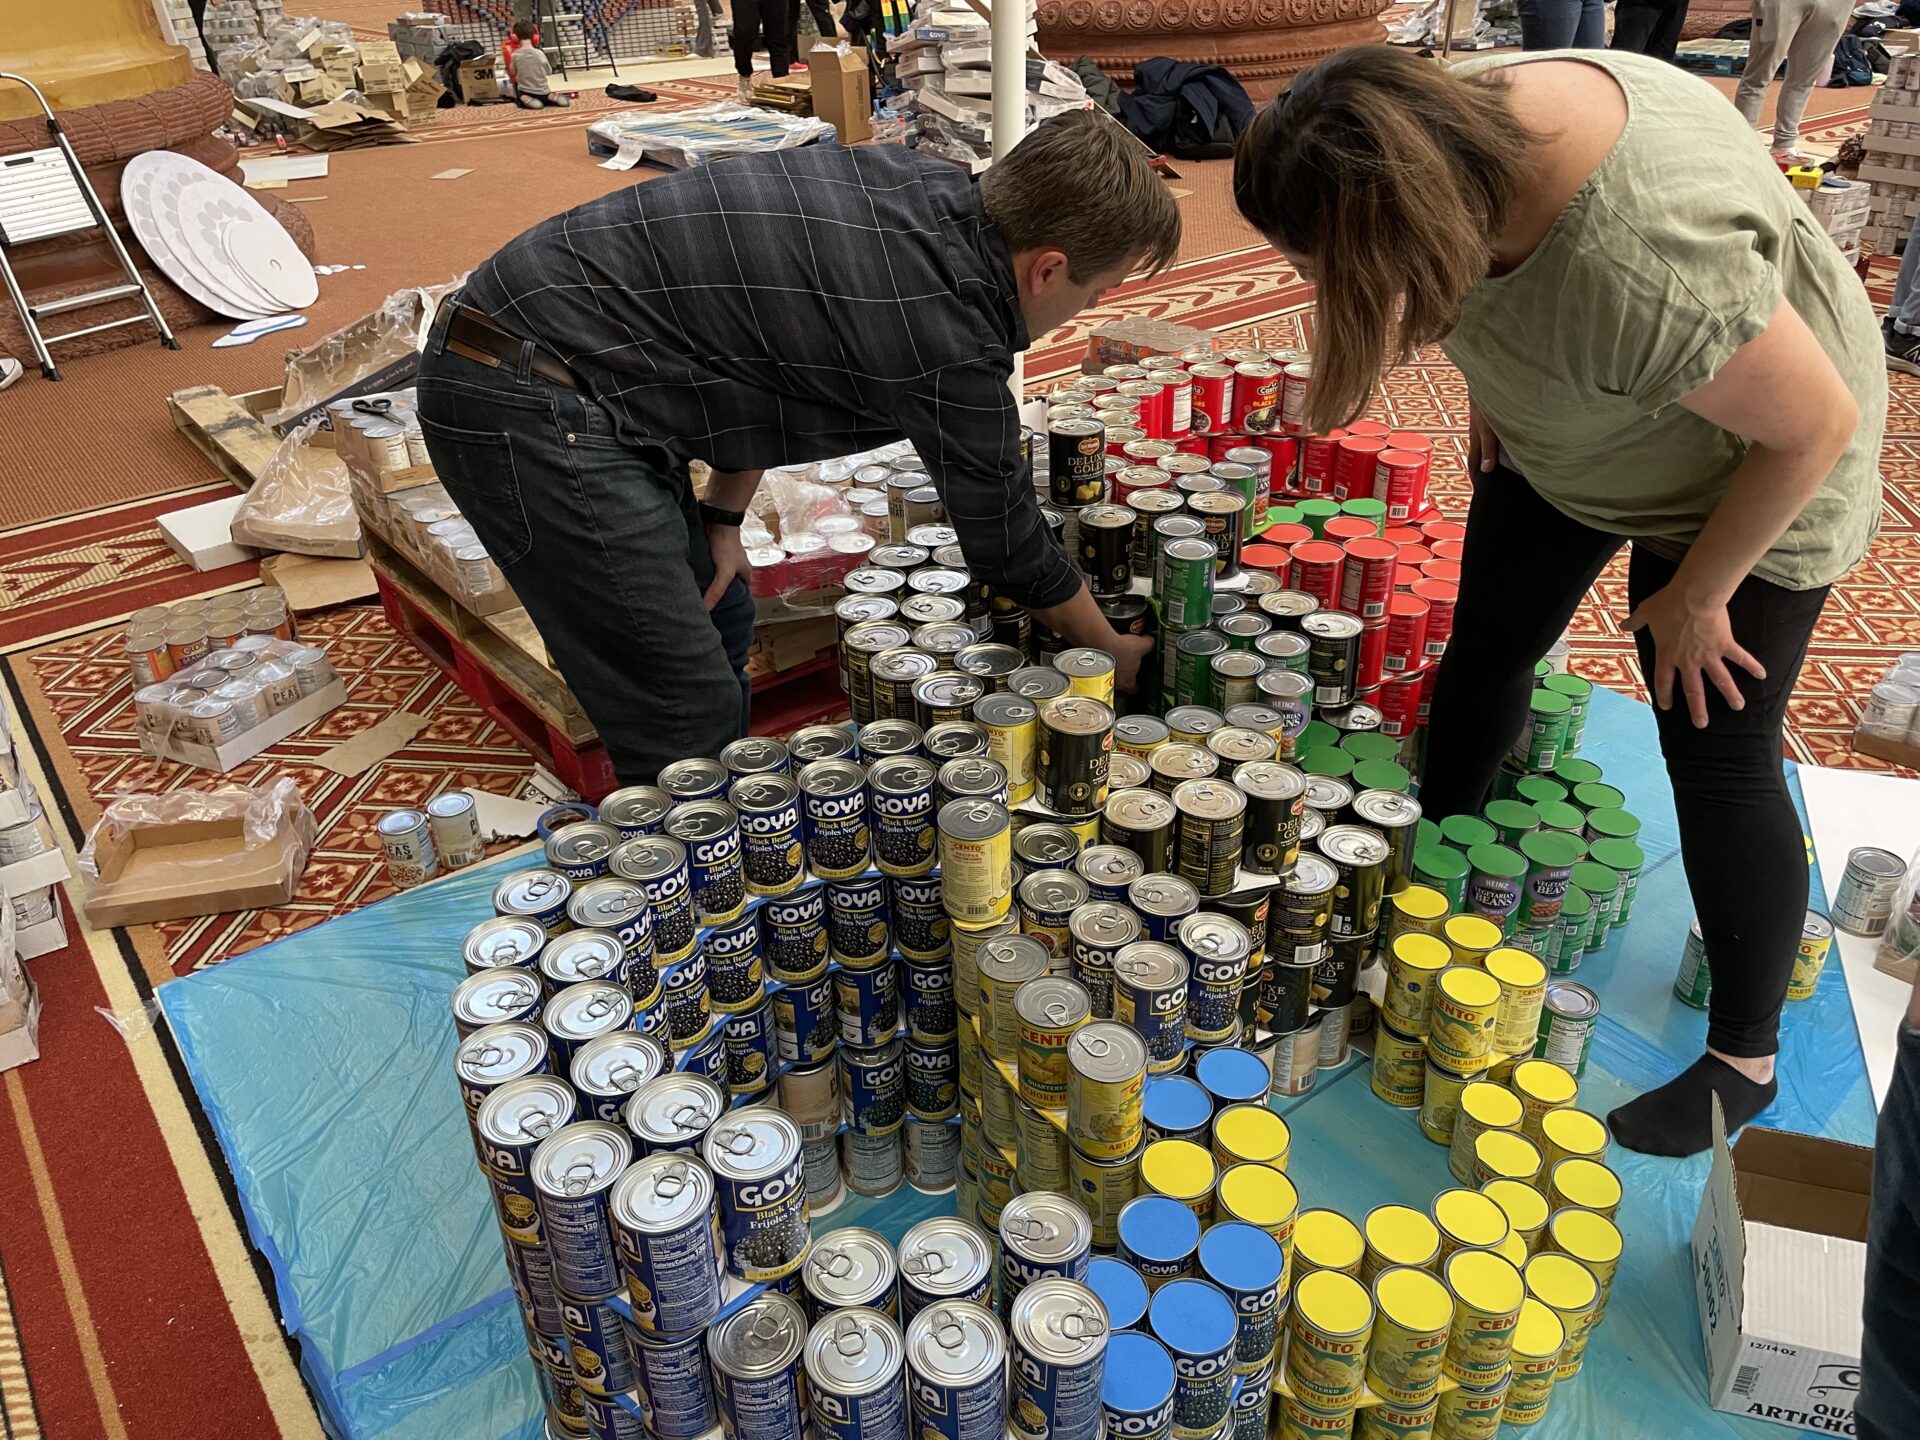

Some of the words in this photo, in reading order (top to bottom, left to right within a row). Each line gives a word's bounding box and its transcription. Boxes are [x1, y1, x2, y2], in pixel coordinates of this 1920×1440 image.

[474, 69, 493, 80] 3M
[302, 407, 326, 424] GOY
[1068, 452, 1104, 466] DELUX
[1074, 462, 1103, 474] GOLD
[1205, 532, 1235, 542] LUXE
[1272, 700, 1295, 708] HEINZ
[1283, 718, 1301, 728] ANS
[988, 729, 1005, 737] NTO
[1089, 754, 1110, 770] DEL
[1095, 764, 1110, 776] GO
[809, 792, 864, 816] GOYA
[874, 792, 930, 813] GOYA
[739, 808, 797, 832] GOYA
[818, 820, 839, 829] Black
[840, 817, 860, 827] Beans
[882, 817, 902, 826] Black
[903, 816, 924, 825] Beans
[1277, 819, 1301, 833] DEL
[621, 830, 645, 839] OYA
[814, 827, 841, 837] Frijoles
[878, 823, 904, 833] Frijoles
[1284, 826, 1300, 839] GO
[748, 837, 770, 845] Black
[771, 833, 792, 843] Beans
[387, 845, 411, 856] EAS
[954, 843, 981, 851] CENTO
[709, 863, 729, 874] Black
[704, 870, 731, 882] Frijoles
[1486, 879, 1509, 890] HEINZ
[1536, 878, 1570, 889] VEGETARI
[828, 886, 881, 908] GOYA
[1474, 886, 1515, 898] VEGETARIAN
[1475, 893, 1514, 907] BEANS
[652, 906, 680, 921] Frijoles
[657, 901, 678, 913] Black
[768, 896, 824, 923] GOYA
[853, 911, 875, 919] Beans
[1401, 916, 1424, 927] CENTO
[618, 907, 652, 945] OYA
[777, 926, 798, 934] Black
[800, 922, 819, 933] Beans
[703, 925, 757, 954] GOYA
[774, 932, 801, 941] Frijoles
[710, 956, 731, 965] Black
[732, 951, 753, 962] Beans
[669, 955, 705, 987] OYA
[876, 963, 895, 986] GO
[1082, 967, 1103, 978] Black
[914, 973, 954, 988] GOY
[810, 977, 832, 1003] GO
[1156, 982, 1188, 1010] GO
[1200, 991, 1228, 999] Frijoles
[726, 1021, 755, 1036] YA
[1401, 1051, 1427, 1059] CEN
[1027, 1079, 1068, 1091] QUARTERE
[462, 1085, 487, 1106] YA
[489, 1146, 517, 1170] YA
[756, 1206, 784, 1221] Black
[584, 1222, 598, 1231] 130
[750, 1213, 788, 1229] Frijoles
[759, 1267, 786, 1278] PRIME
[1002, 1259, 1061, 1285] OYA
[1141, 1264, 1179, 1275] GOYA
[964, 1284, 987, 1301] OYA
[1240, 1285, 1281, 1313] GO
[1296, 1322, 1355, 1354] CENTO
[1416, 1331, 1449, 1350] CEN
[1750, 1342, 1778, 1353] 12/14
[1781, 1348, 1797, 1356] OZ
[688, 1363, 700, 1374] 130
[1524, 1357, 1557, 1373] CEN
[910, 1370, 940, 1408] YA
[1180, 1386, 1215, 1396] Frijoles
[1187, 1380, 1213, 1389] Black
[777, 1394, 788, 1404] 130
[1327, 1391, 1358, 1403] HEART
[1387, 1386, 1433, 1399] ARTICHO
[1106, 1399, 1173, 1433] GOYA
[1289, 1406, 1347, 1429] CENTO
[1376, 1407, 1433, 1425] CENTO
[1747, 1402, 1857, 1436] ARTICHO
